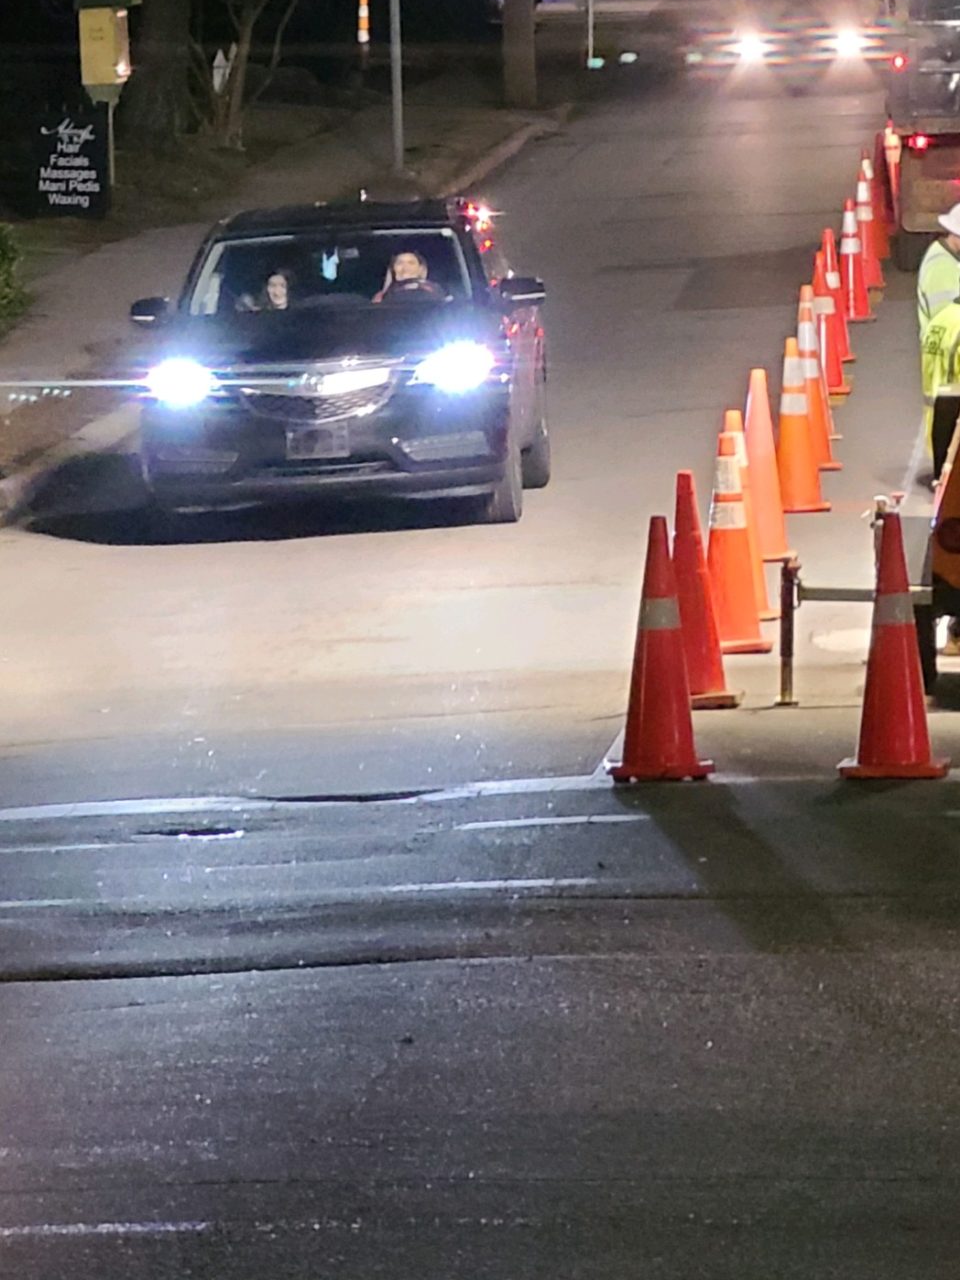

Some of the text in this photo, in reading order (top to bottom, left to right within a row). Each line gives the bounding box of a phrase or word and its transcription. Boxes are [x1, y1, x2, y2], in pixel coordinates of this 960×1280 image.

[57, 141, 81, 153] Hair
[50, 154, 90, 167] Facials
[40, 167, 97, 181] Massages
[39, 180, 100, 192] Mani Pedis
[48, 193, 90, 208] Waxing
